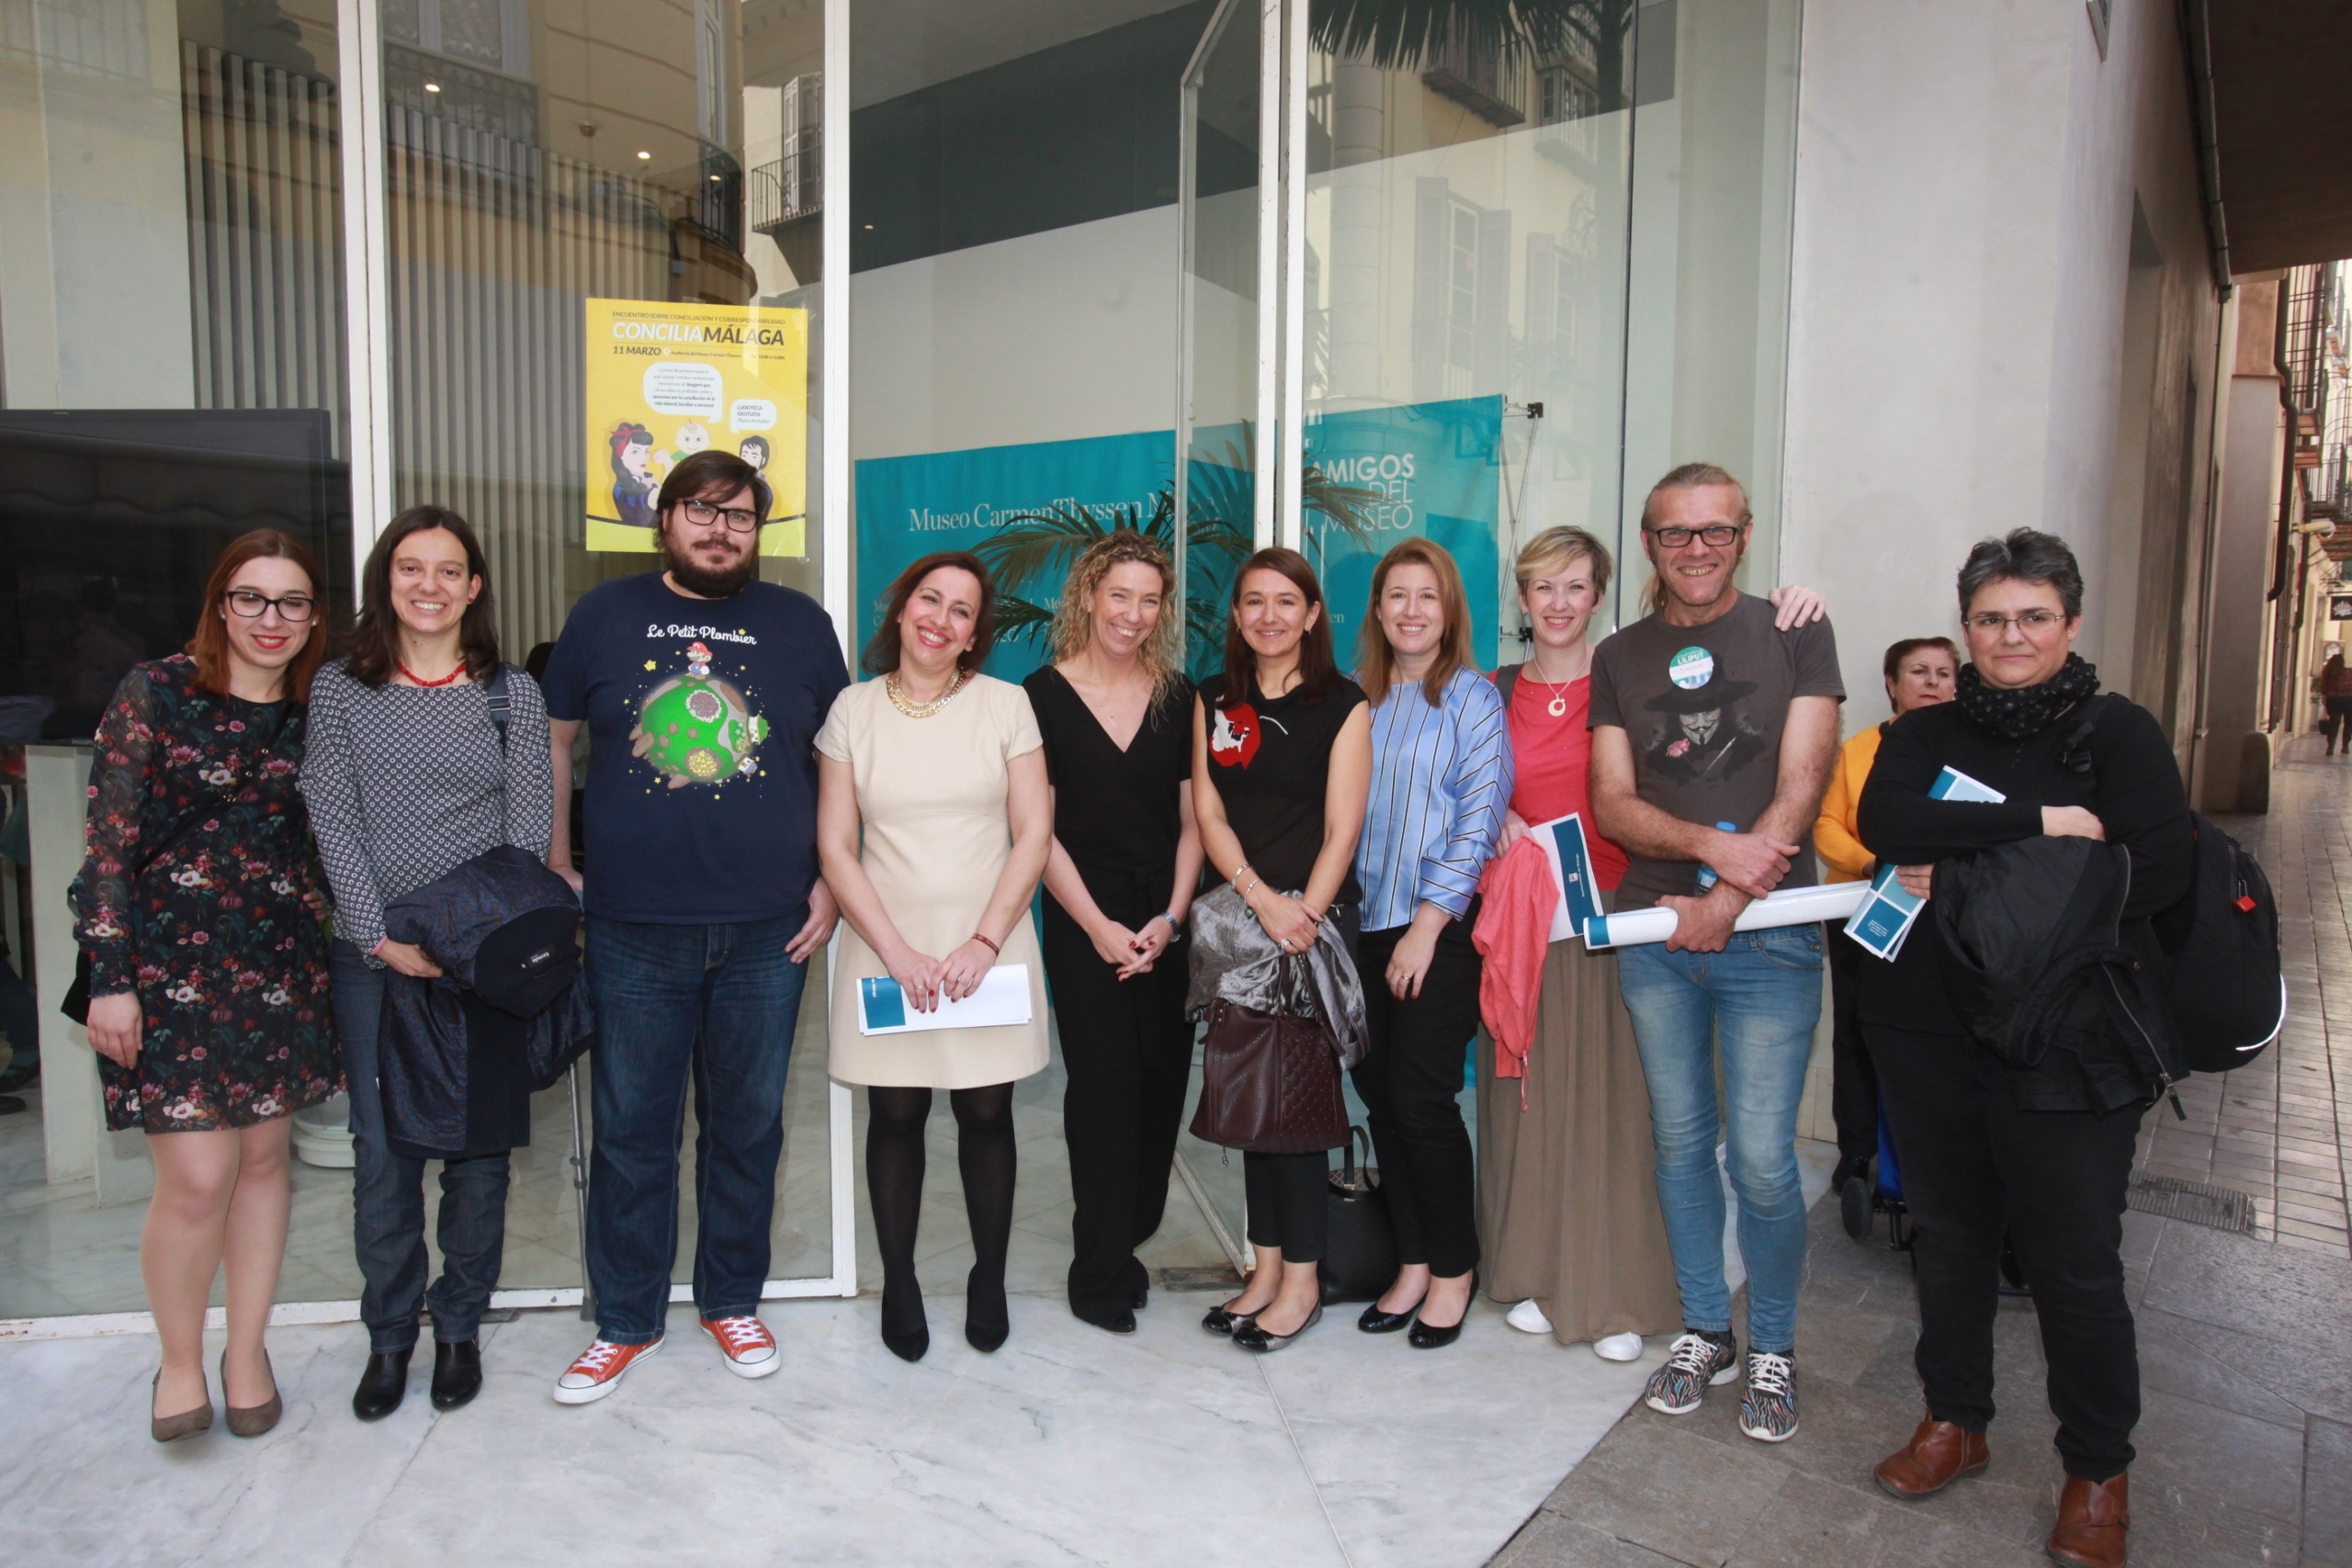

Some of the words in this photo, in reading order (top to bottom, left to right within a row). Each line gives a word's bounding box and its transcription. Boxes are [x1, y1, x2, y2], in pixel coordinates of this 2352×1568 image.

[670, 314, 714, 322] CONCILIACIÓN
[719, 316, 786, 325] CORRESPONSABILIDAD
[613, 345, 625, 355] 11
[626, 346, 662, 355] MARZO
[1310, 453, 1415, 484] AMIGOS
[1368, 479, 1414, 505] DEL
[909, 507, 970, 531] Museo
[973, 502, 1054, 528] Carmen
[647, 624, 665, 637] Le
[667, 624, 698, 638] Petit
[699, 626, 757, 645] Plombier
[1678, 652, 1703, 665] LILIPUT
